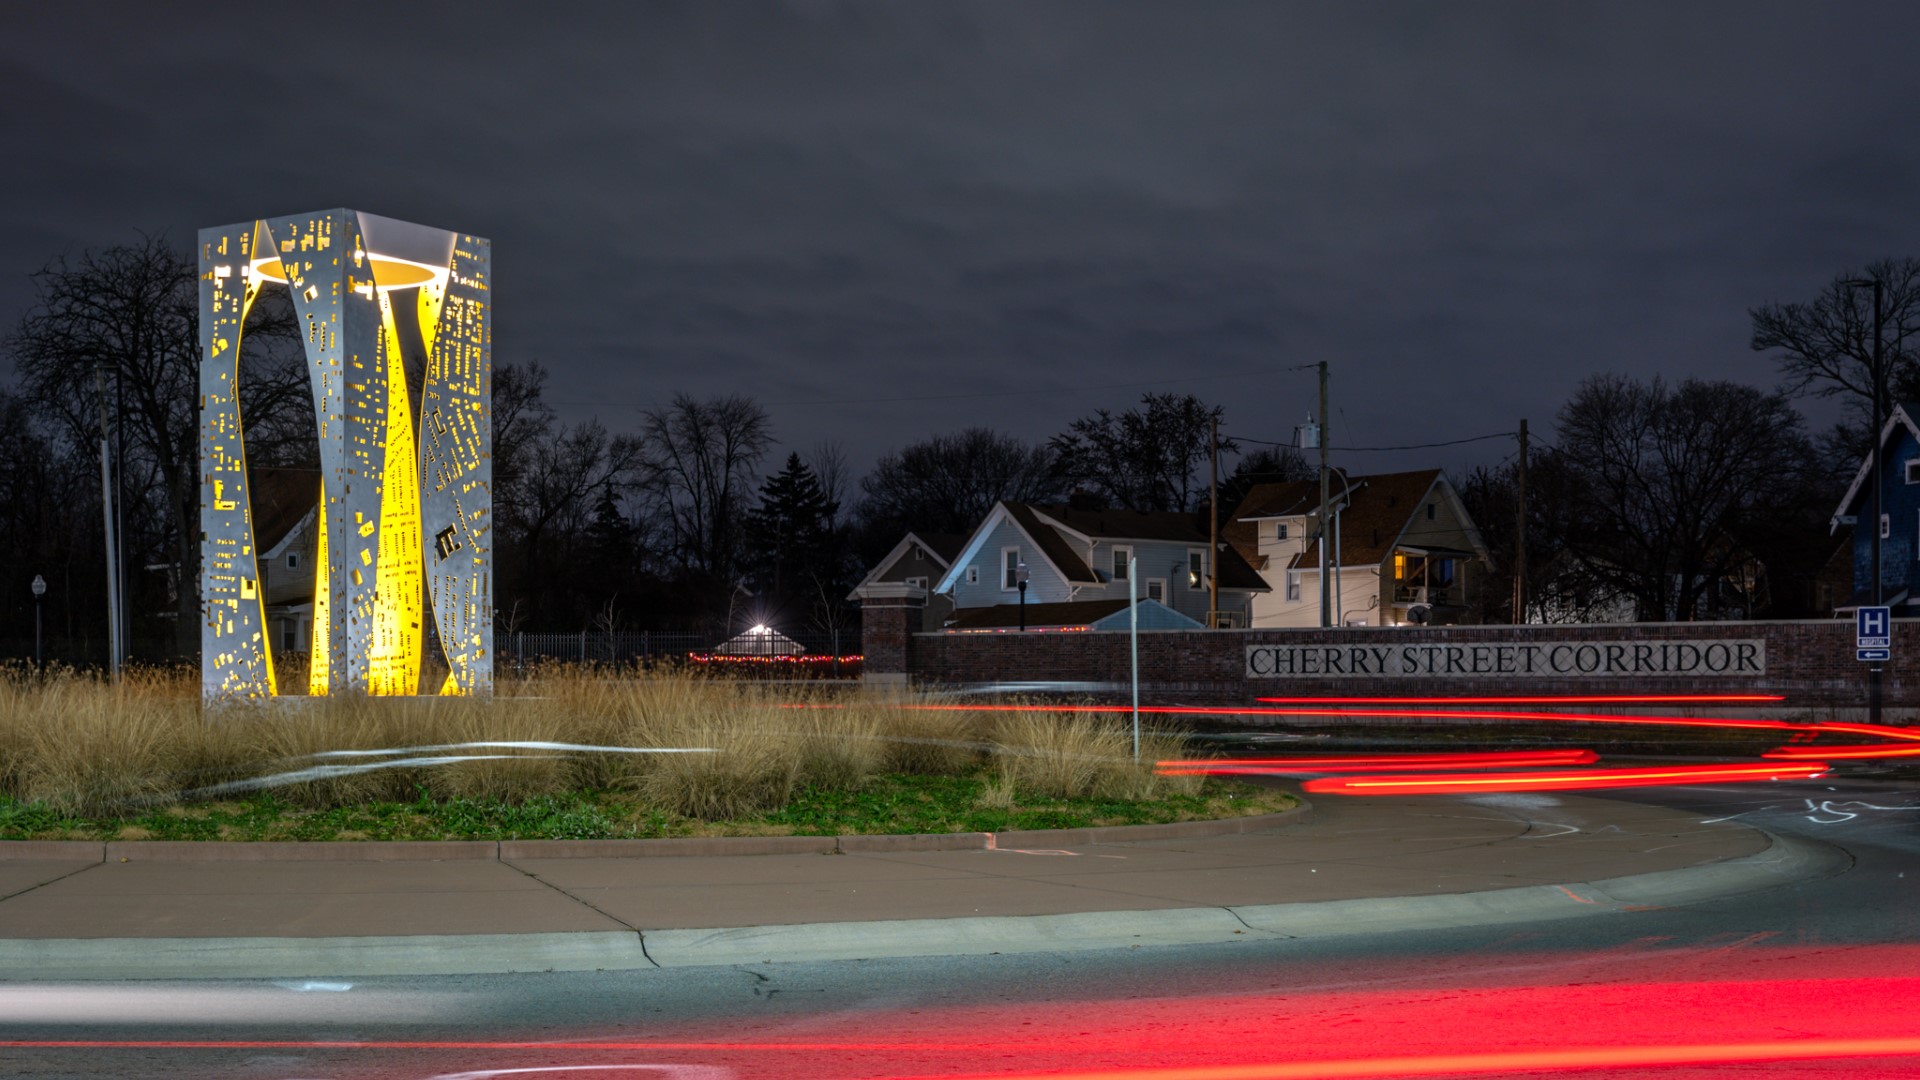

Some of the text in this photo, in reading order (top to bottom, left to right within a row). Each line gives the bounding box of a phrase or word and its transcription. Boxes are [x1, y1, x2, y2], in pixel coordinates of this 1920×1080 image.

[1864, 612, 1882, 634] H
[1250, 644, 1762, 674] CHERRY STREET CORRIDOR
